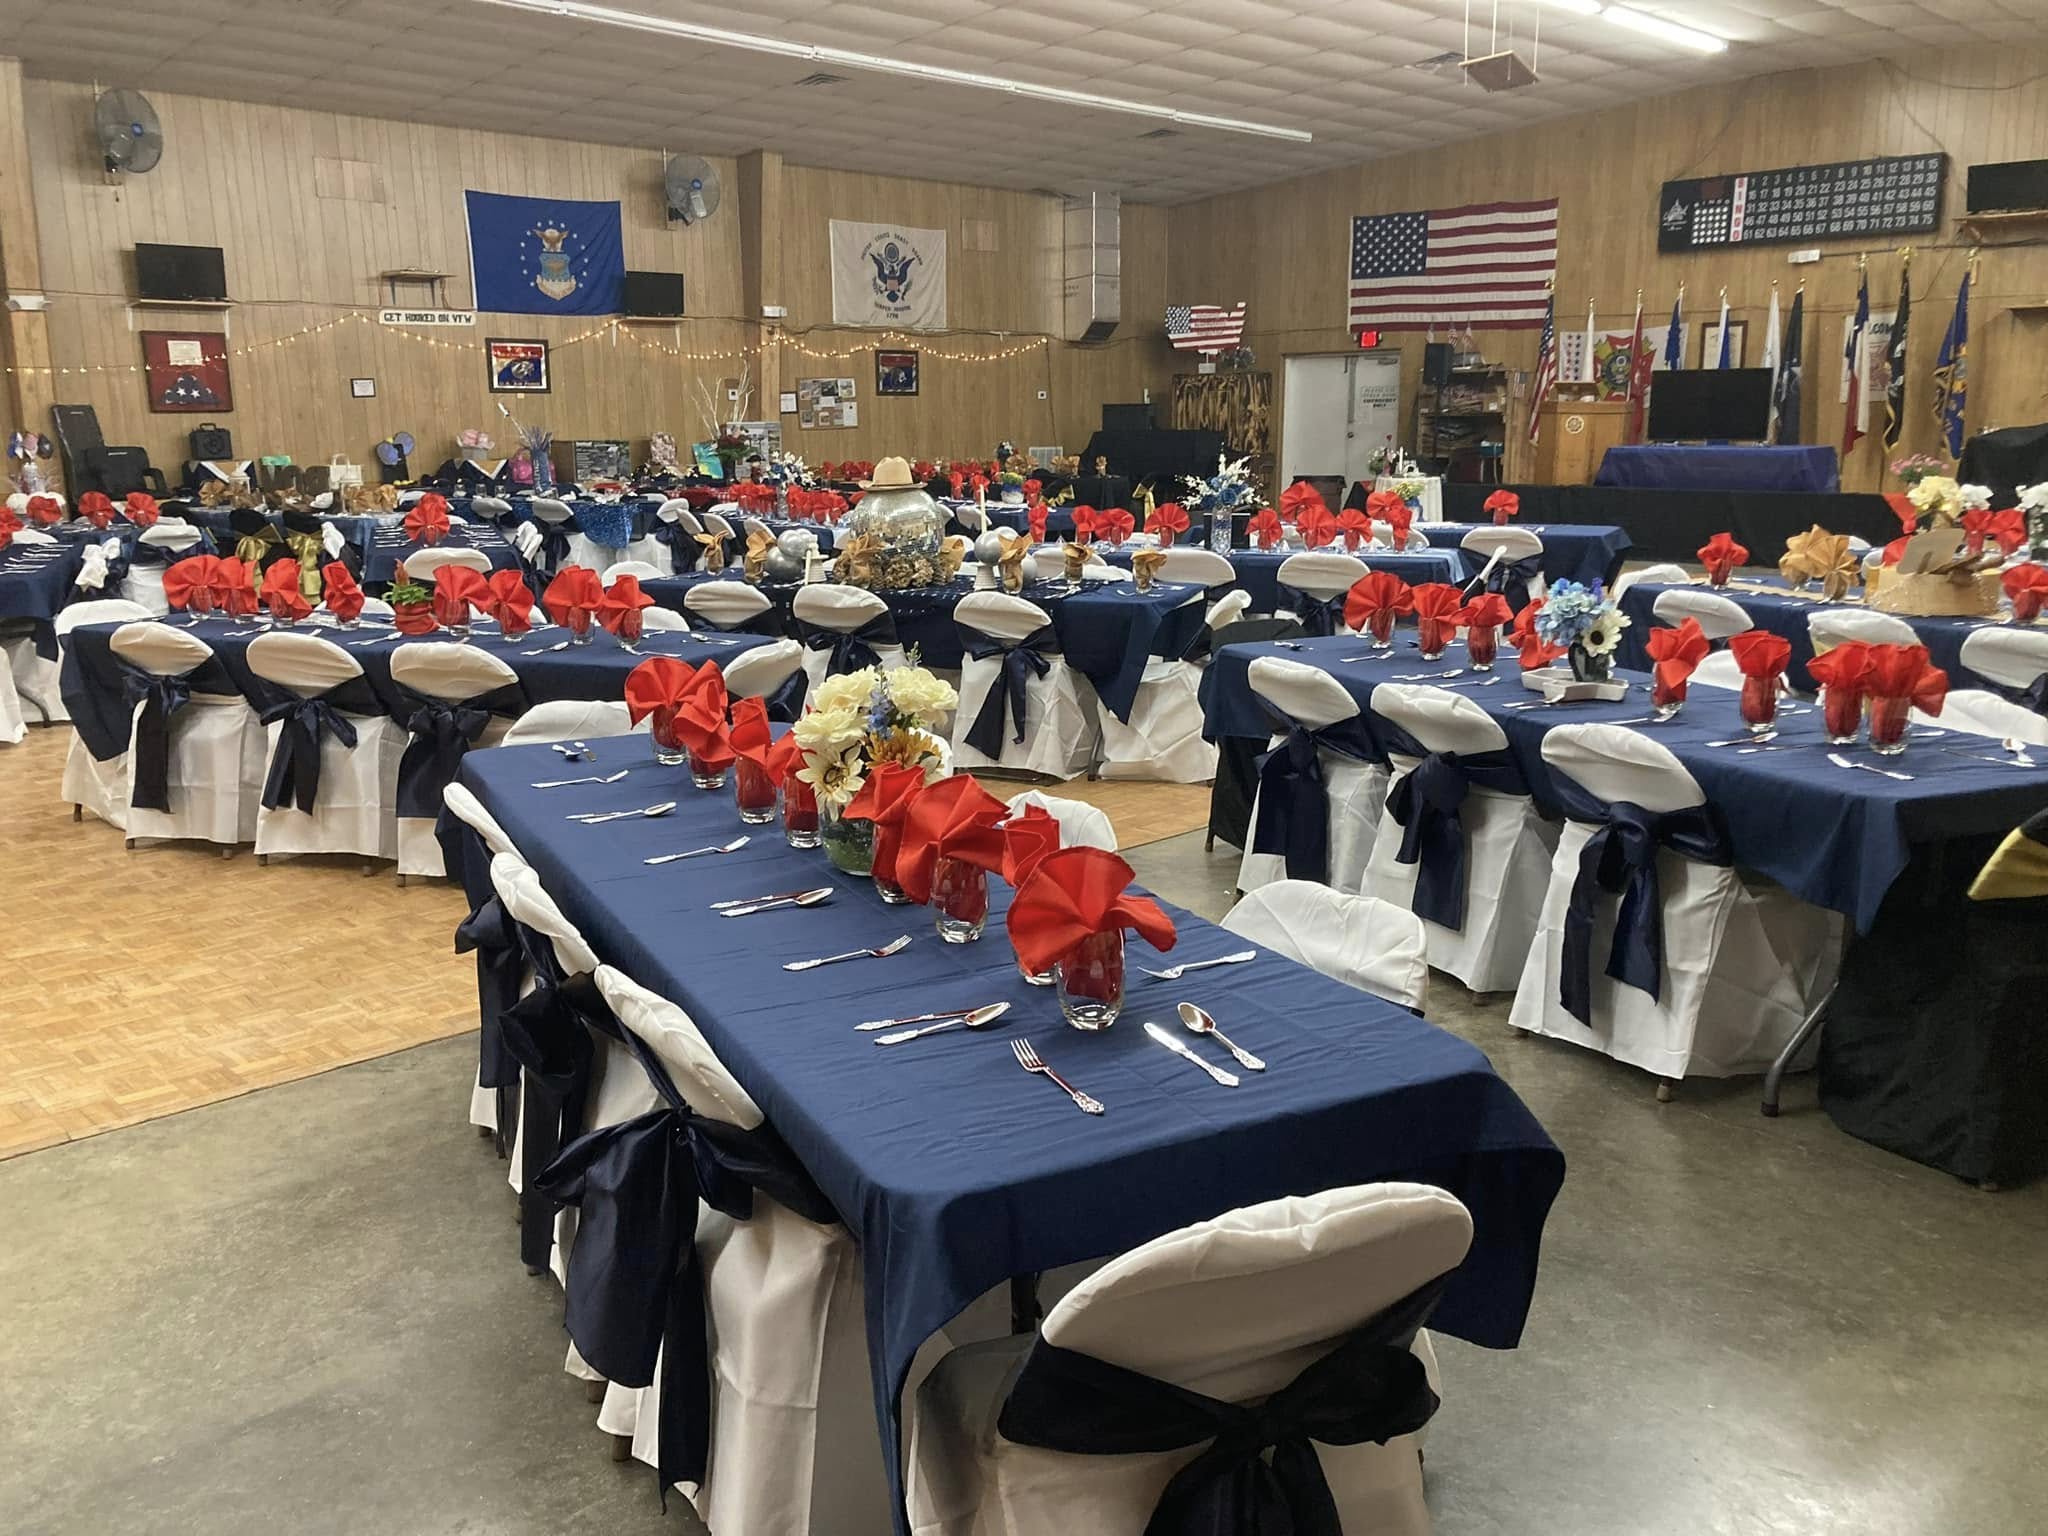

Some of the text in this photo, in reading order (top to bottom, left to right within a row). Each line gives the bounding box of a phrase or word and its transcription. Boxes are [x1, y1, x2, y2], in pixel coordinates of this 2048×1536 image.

[1749, 172, 1938, 200] 16 17 18 19 20 21 22 23 24 25 26 27 28 29 30
[1751, 158, 1938, 187] 1 2 3 4 5 6 7 8 9 10 11 12 13 14 15
[1744, 200, 1934, 226] 46 47 48 49 50 51 52 53 54 55 56 57 58 59 60
[1746, 186, 1936, 213] 31 32 33 34 35 36 37 38 39 40 41 42 43 44 45
[1744, 213, 1933, 240] 61 62 63 64 65 66 67 68 69 70 71 72 73 74 75
[384, 313, 472, 323] GET HOOKED ON VFW
